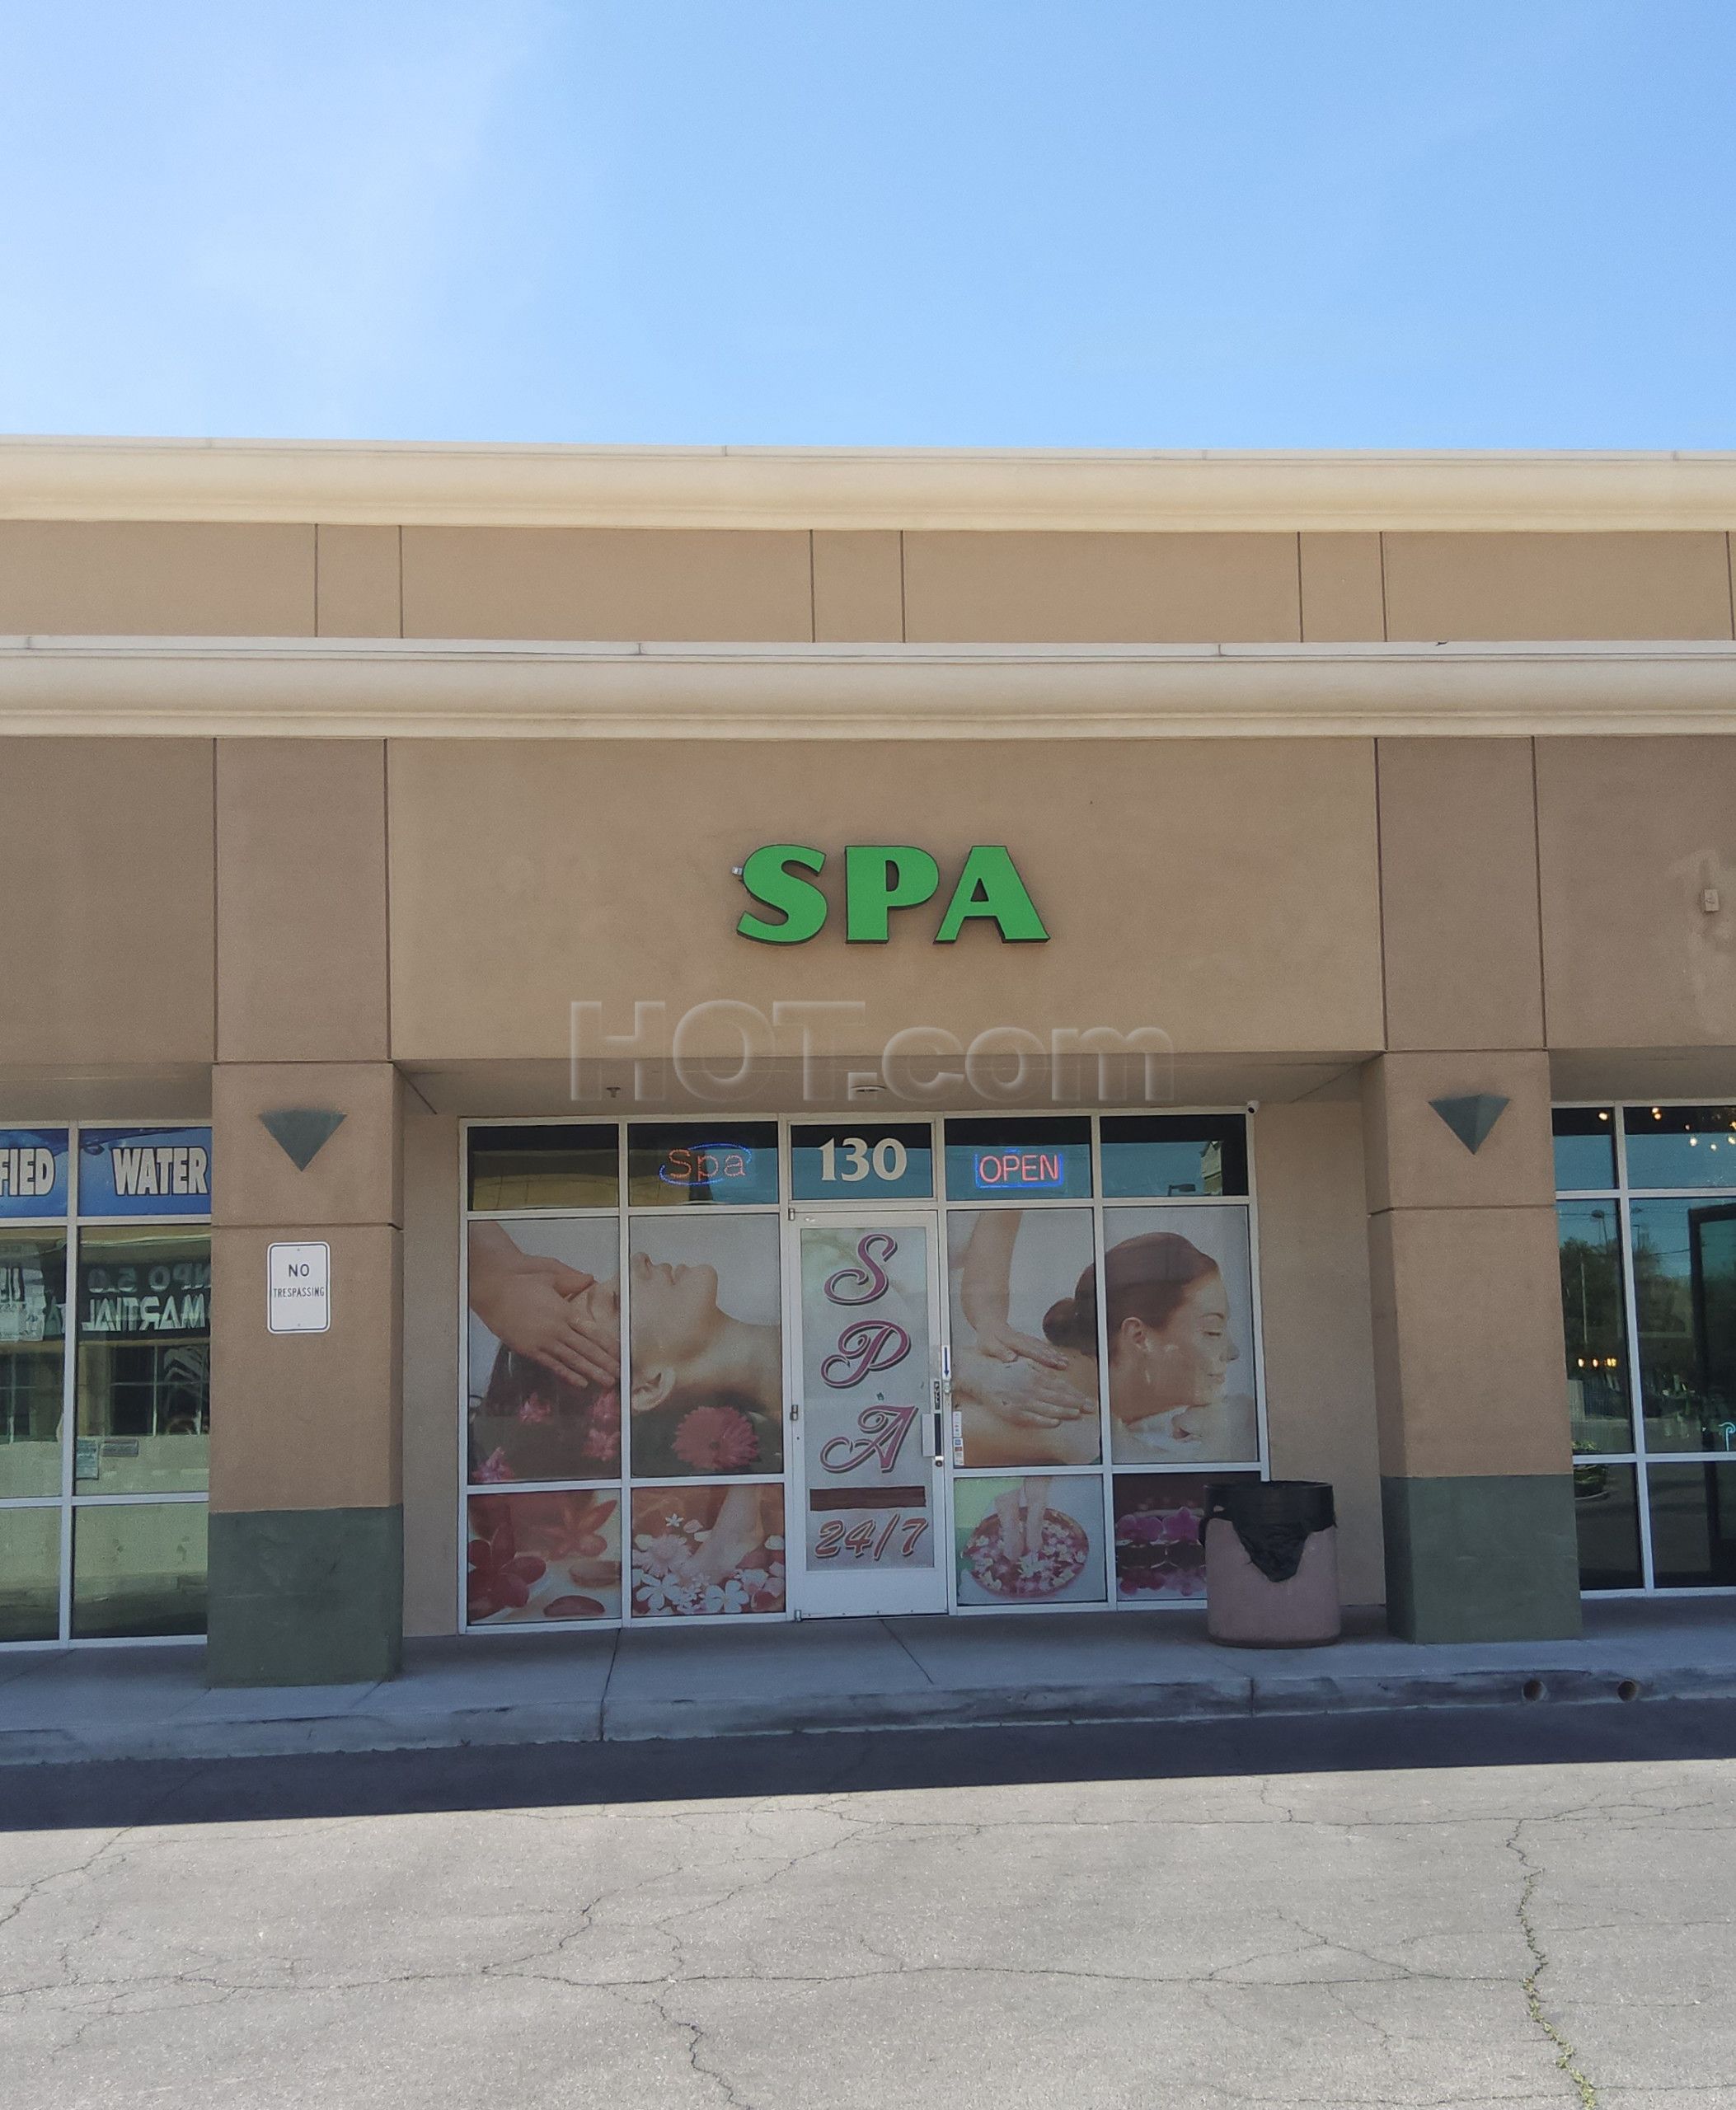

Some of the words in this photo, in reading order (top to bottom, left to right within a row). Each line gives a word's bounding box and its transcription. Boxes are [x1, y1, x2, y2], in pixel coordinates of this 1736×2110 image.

[736, 844, 1051, 945] SPA
[111, 1146, 209, 1195] WATER
[668, 1149, 747, 1180] Spa
[818, 1137, 907, 1182] 130
[978, 1154, 1059, 1184] OPEN
[289, 1264, 310, 1278] NO
[273, 1287, 325, 1298] TRESPASSING
[814, 1513, 929, 1560] 24/7
